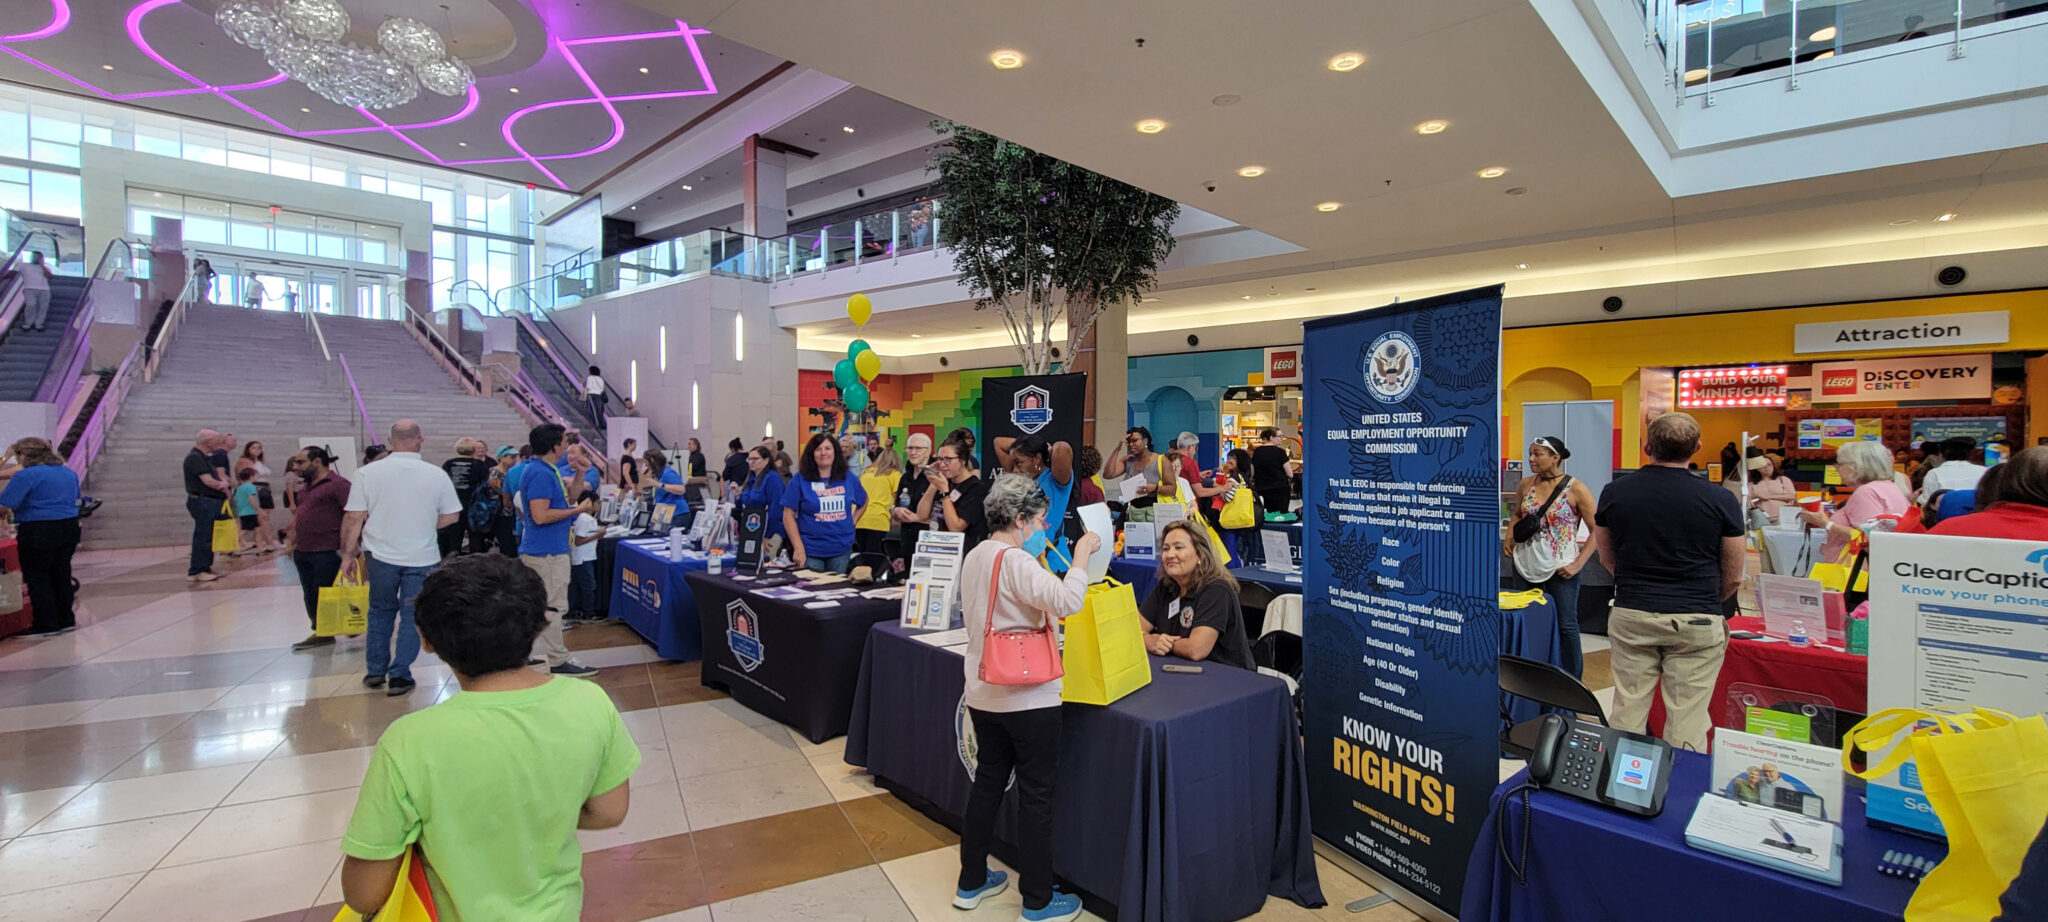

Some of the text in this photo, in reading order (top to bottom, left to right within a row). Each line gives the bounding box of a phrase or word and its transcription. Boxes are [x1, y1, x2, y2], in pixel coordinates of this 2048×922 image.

[1835, 322, 1961, 343] Attraction
[1371, 336, 1388, 351] EQUAL
[1389, 333, 1418, 358] EMPLOYMENT
[1273, 359, 1294, 370] LEGO
[1701, 375, 1778, 386] BUILD YOUR
[1825, 376, 1855, 388] LEGO
[1864, 381, 1921, 391] CENTER
[1692, 386, 1787, 399] MINIFIGURE
[1361, 412, 1422, 425] UNITED STATES
[1327, 426, 1469, 440] EQUAL EMPLOYMENT OPPORTUNITY
[1365, 443, 1418, 454] COMMISSION
[1329, 478, 1340, 487] The
[1340, 479, 1351, 488] U.S.
[1352, 479, 1369, 488] EEOC
[1377, 480, 1416, 491] responsible
[1416, 482, 1427, 491] for
[1428, 483, 1466, 495] enforcing
[1338, 490, 1360, 500] federal
[1361, 491, 1376, 500] laws
[1377, 492, 1391, 502] that
[1392, 493, 1411, 503] make
[1418, 494, 1441, 506] illegal
[1442, 496, 1451, 506] to
[1329, 500, 1365, 512] discriminate
[1366, 504, 1391, 514] against
[1397, 505, 1409, 517] job
[1409, 507, 1444, 518] applicant
[1444, 510, 1453, 519] or
[1454, 511, 1465, 520] an
[1338, 514, 1450, 532] employee because of the person's
[1382, 536, 1400, 547] Race
[1381, 556, 1400, 567] Color
[1376, 575, 1405, 589] Religion
[1901, 584, 1946, 596] Know
[1950, 589, 1989, 601] your
[1328, 585, 1465, 623] Sex (including pregnancy, gender identity,
[1358, 603, 1397, 619] transgender
[1398, 612, 1419, 625] status
[1420, 618, 1434, 629] and
[1435, 621, 1461, 634] sexual
[1371, 619, 1410, 637] orientation)
[1366, 635, 1415, 657] National Origin
[1362, 654, 1419, 680] Age (40 Or Older)
[1374, 677, 1406, 697] Disability
[1358, 691, 1424, 722] Genetic Information
[1343, 715, 1444, 775] KNOW YOUR
[1721, 740, 1749, 751] Trouble
[1750, 745, 1779, 757] hearing
[1791, 754, 1805, 762] the
[1805, 758, 1835, 768] phone?
[1333, 736, 1455, 824] RIGHTS!
[1352, 799, 1431, 845] WASHINGTON FIELD OFFICE
[1370, 820, 1411, 845] www.eeoc.gov
[1356, 831, 1427, 876] PHONE 1-800-669-4000
[1355, 841, 1372, 856] VIDEO
[1372, 849, 1392, 868] PHONE
[1397, 864, 1441, 895] 844-234-5122
